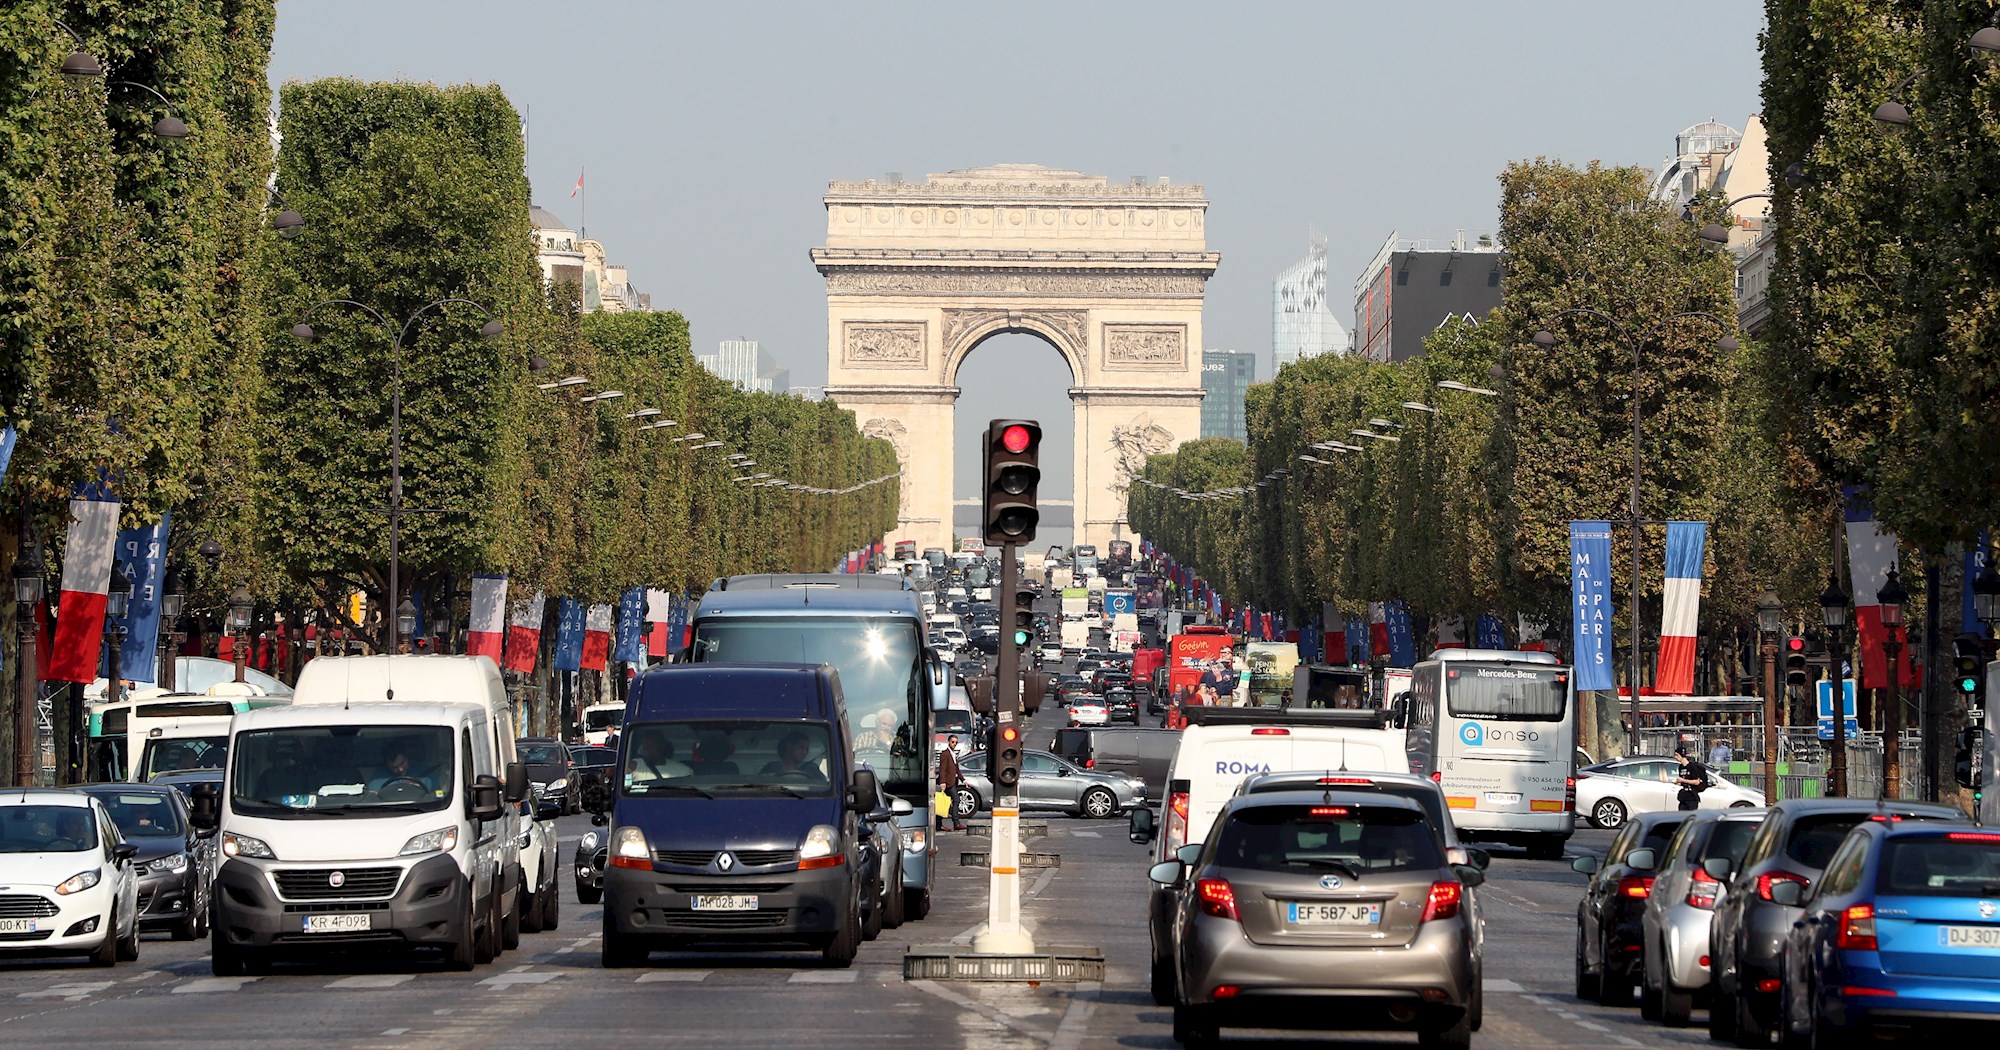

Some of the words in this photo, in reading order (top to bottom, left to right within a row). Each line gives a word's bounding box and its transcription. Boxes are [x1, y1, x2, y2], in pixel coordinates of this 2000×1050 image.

[1576, 553, 1590, 635] MAIRIE
[1593, 594, 1604, 665] PARIS
[1477, 669, 1537, 680] Mercedes-Benz
[1216, 761, 1272, 774] ROMA
[310, 917, 327, 928] KR
[332, 915, 367, 927] 4F098
